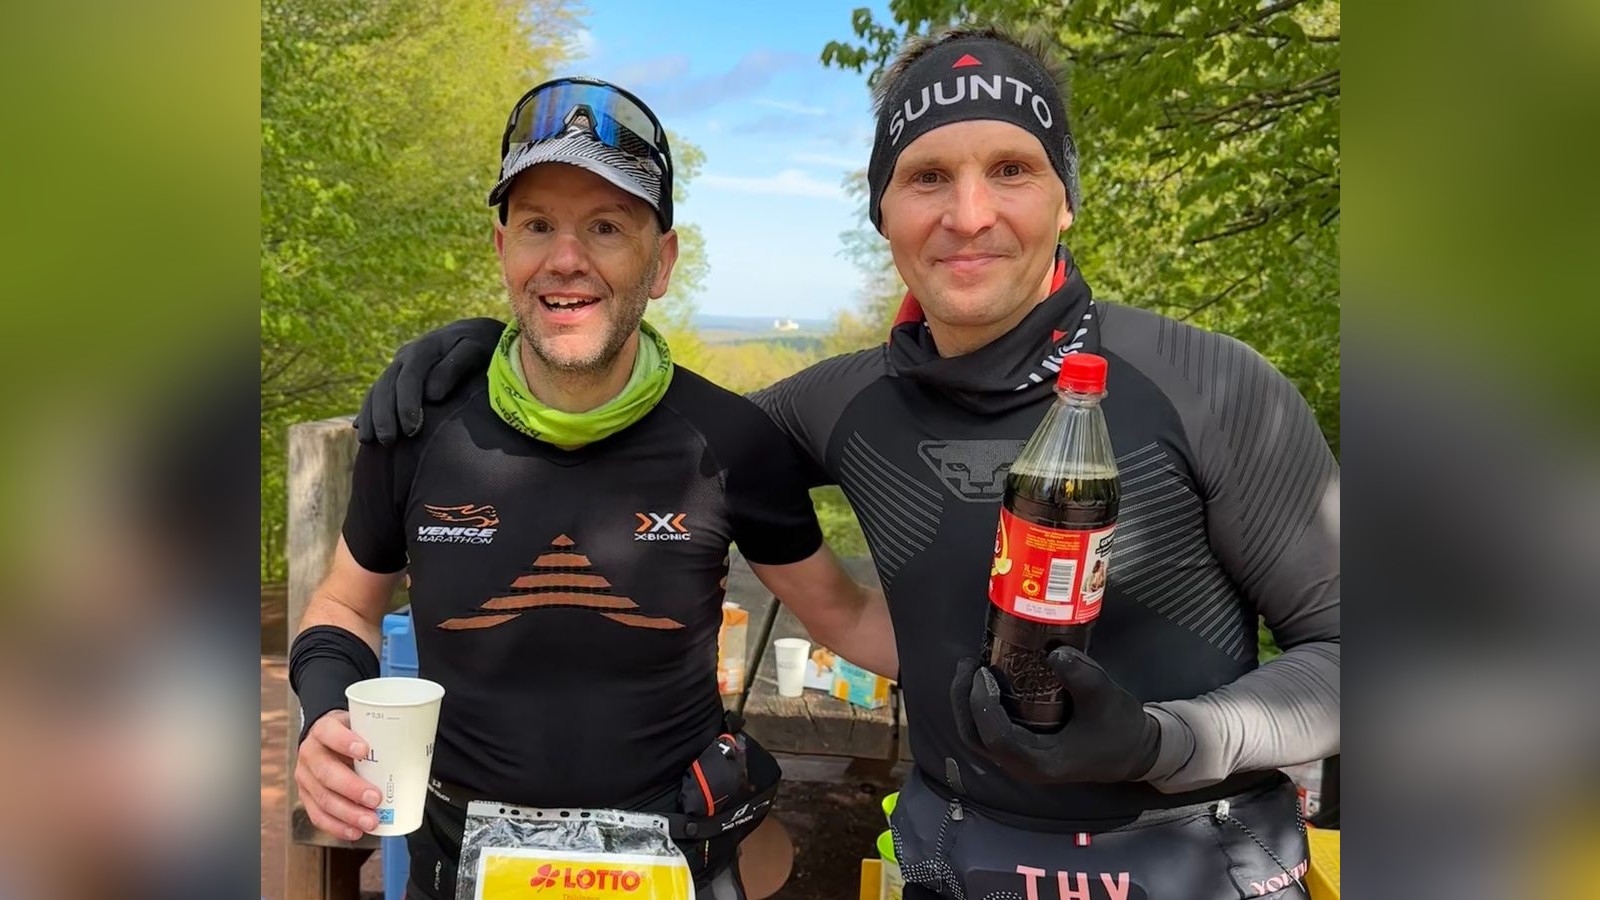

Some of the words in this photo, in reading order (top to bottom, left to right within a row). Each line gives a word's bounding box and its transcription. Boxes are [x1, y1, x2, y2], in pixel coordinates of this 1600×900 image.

[889, 74, 1053, 146] SUUNTO
[417, 535, 494, 545] MARATHON
[418, 526, 497, 537] VENICE
[564, 869, 641, 892] LOTTO
